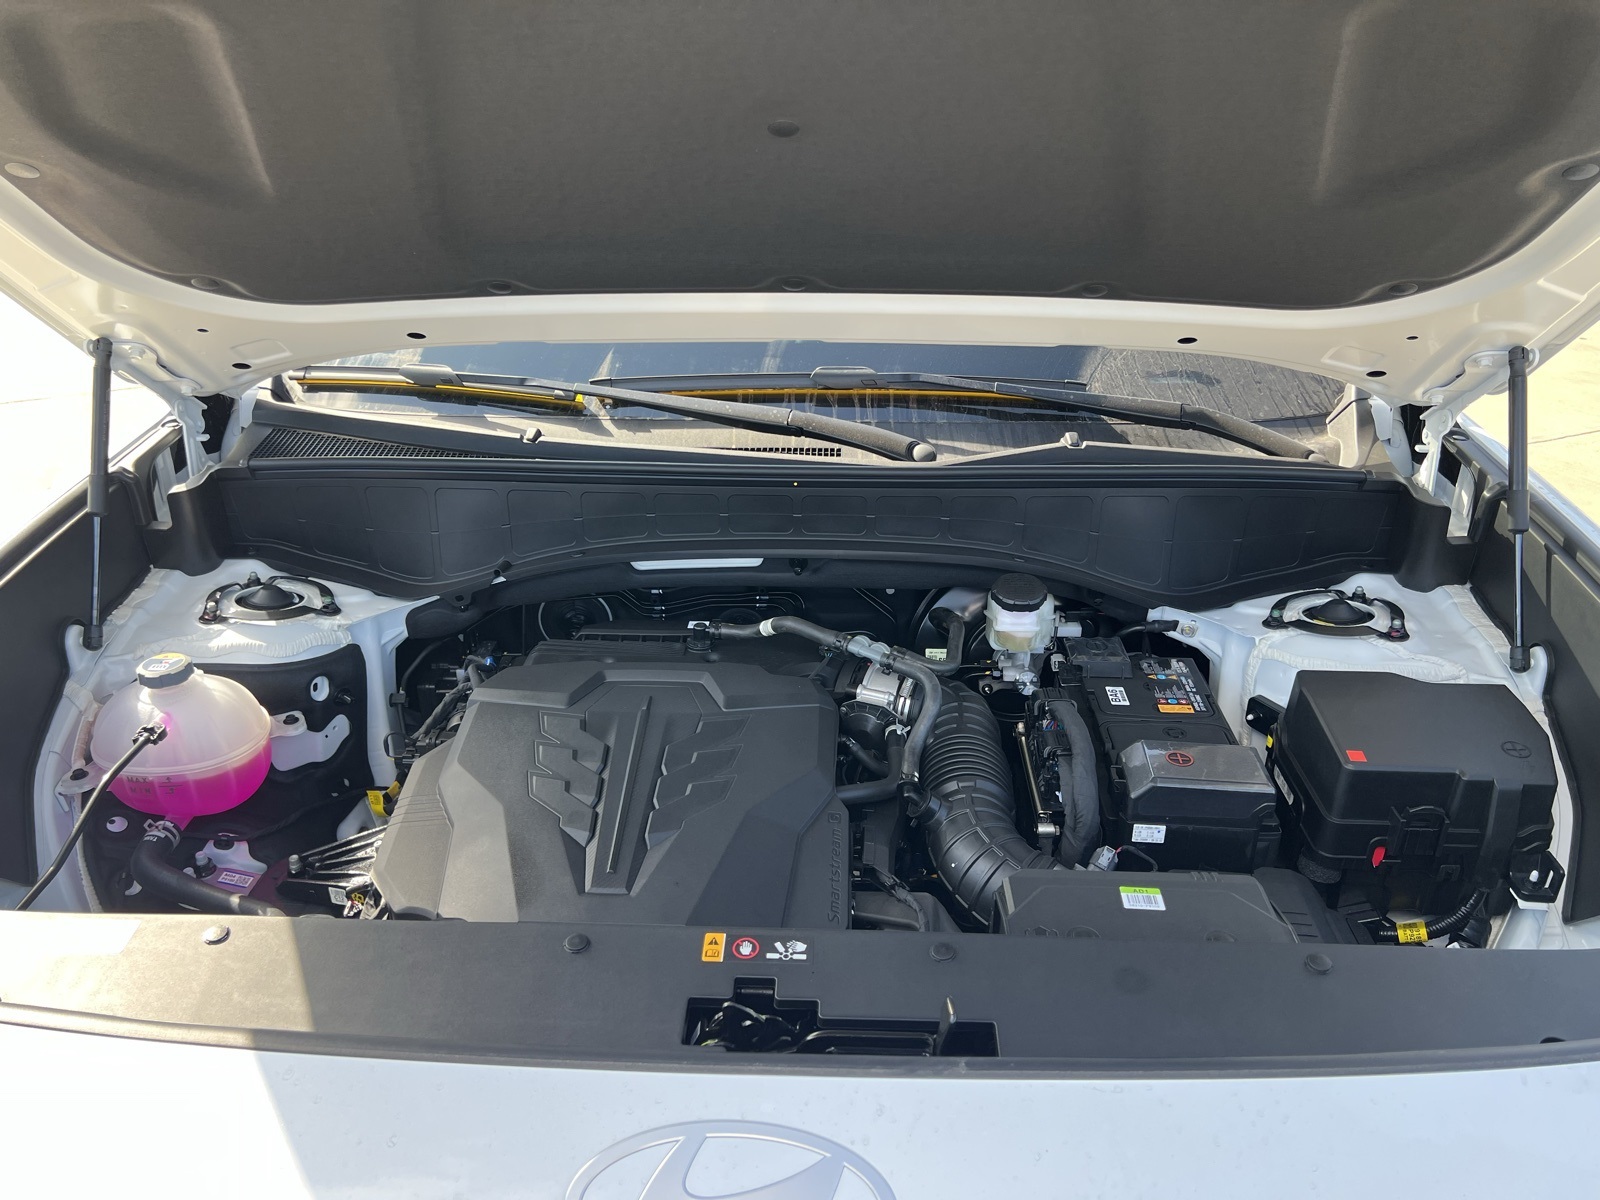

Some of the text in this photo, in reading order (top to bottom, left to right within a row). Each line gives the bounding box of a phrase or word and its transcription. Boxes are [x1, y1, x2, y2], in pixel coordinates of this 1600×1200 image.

[1107, 689, 1121, 703] BA6
[827, 811, 842, 925] Smartstream G
